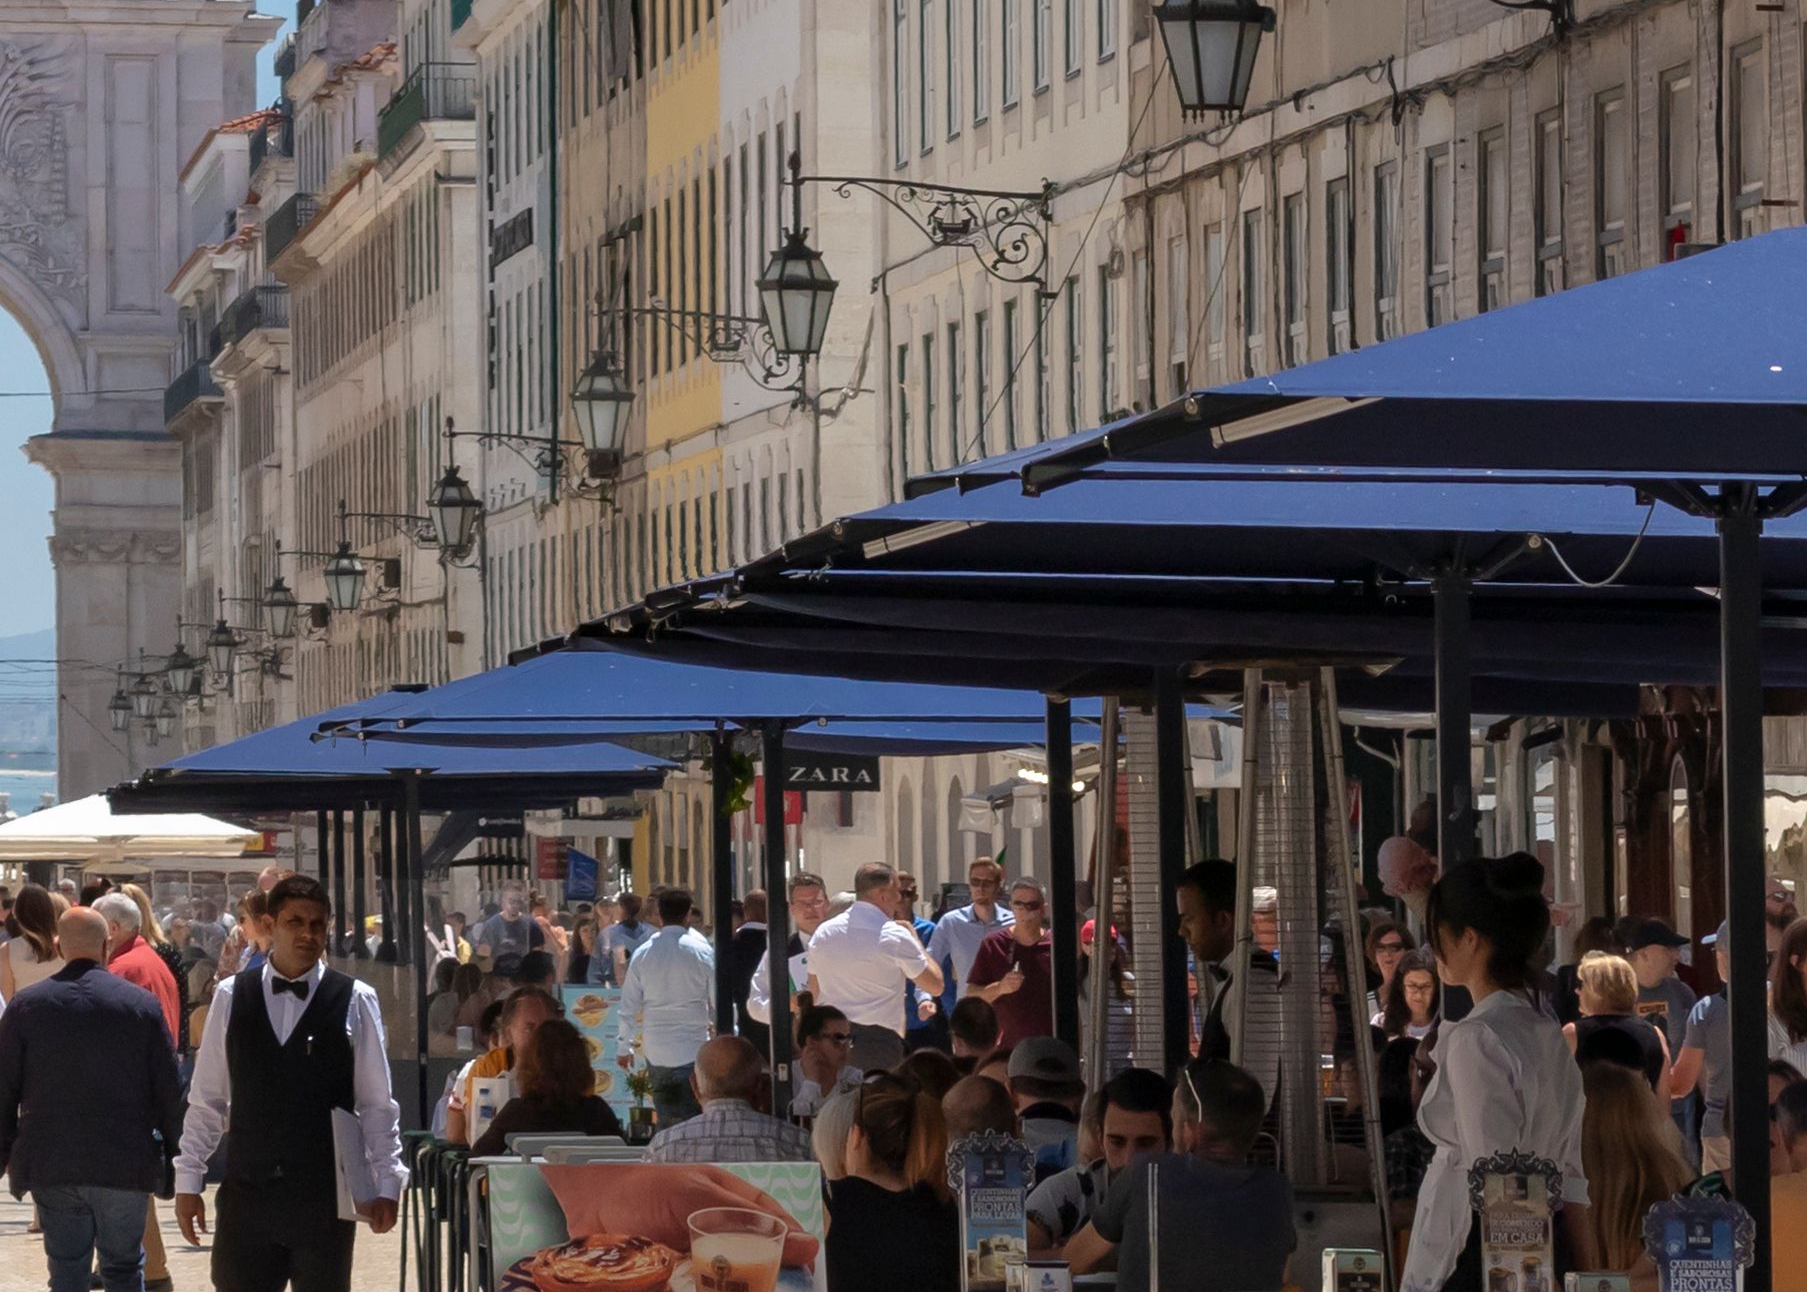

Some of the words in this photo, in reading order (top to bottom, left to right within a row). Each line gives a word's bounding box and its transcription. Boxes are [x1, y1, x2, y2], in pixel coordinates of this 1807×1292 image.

[789, 767, 872, 783] ZARA
[1670, 1260, 1732, 1269] QUENTINHAS
[1671, 1278, 1733, 1290] PRONTAS
